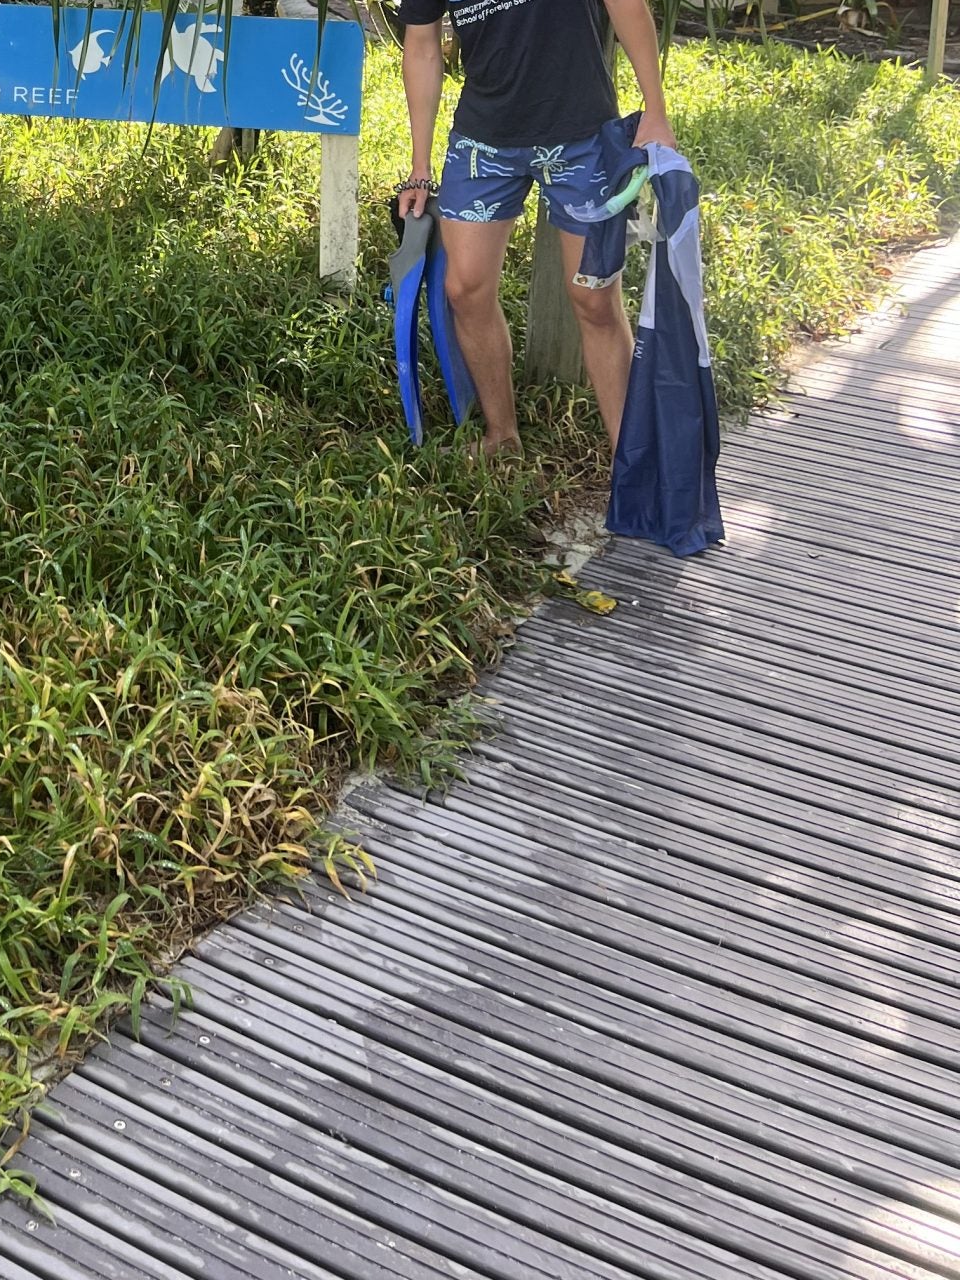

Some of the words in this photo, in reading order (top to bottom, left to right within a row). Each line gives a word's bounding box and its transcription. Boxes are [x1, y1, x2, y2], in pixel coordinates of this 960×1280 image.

[456, 14, 477, 27] School
[477, 9, 486, 21] of
[486, 1, 513, 17] Foreign
[13, 86, 79, 105] REEF
